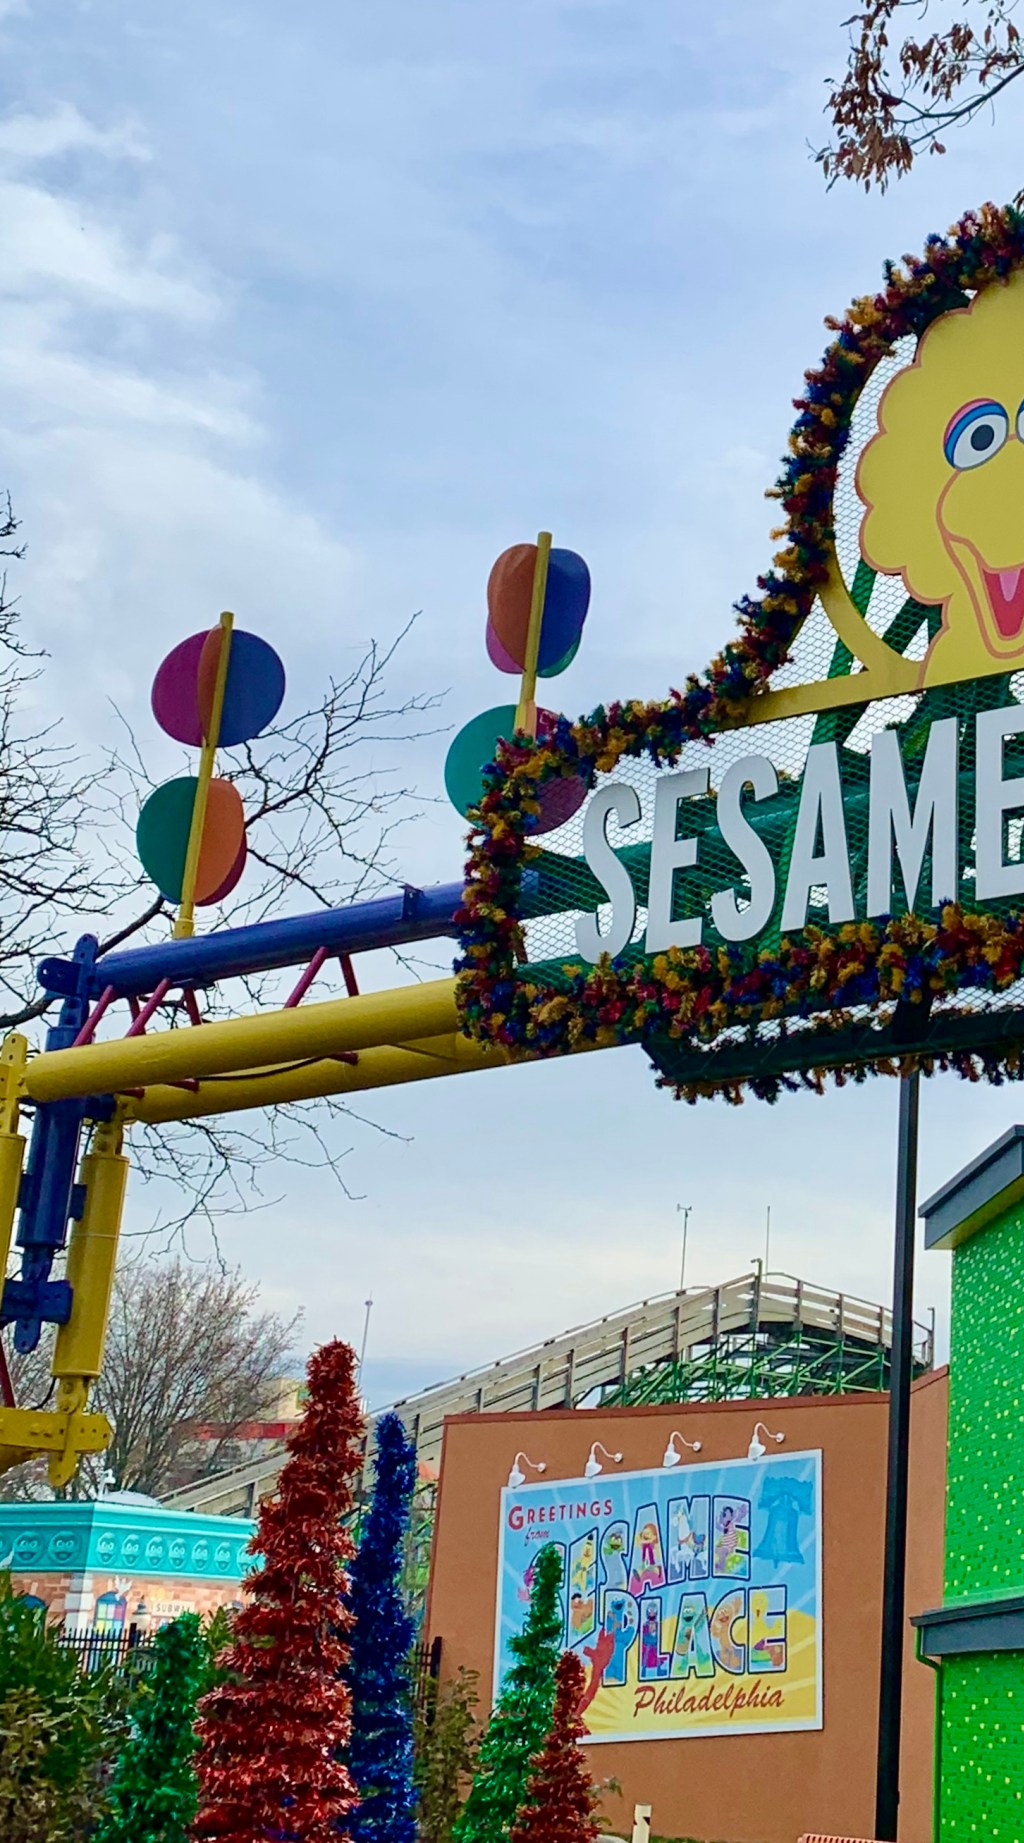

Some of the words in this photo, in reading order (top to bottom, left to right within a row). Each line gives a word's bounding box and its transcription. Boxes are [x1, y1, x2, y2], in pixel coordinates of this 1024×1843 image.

[508, 1499, 613, 1530] GREETINGS
[524, 1517, 550, 1546] from
[523, 1494, 753, 1651] ESAME
[156, 1603, 190, 1612] SUBW
[601, 1584, 788, 1687] PLACE
[633, 1679, 785, 1718] Philadelphia
